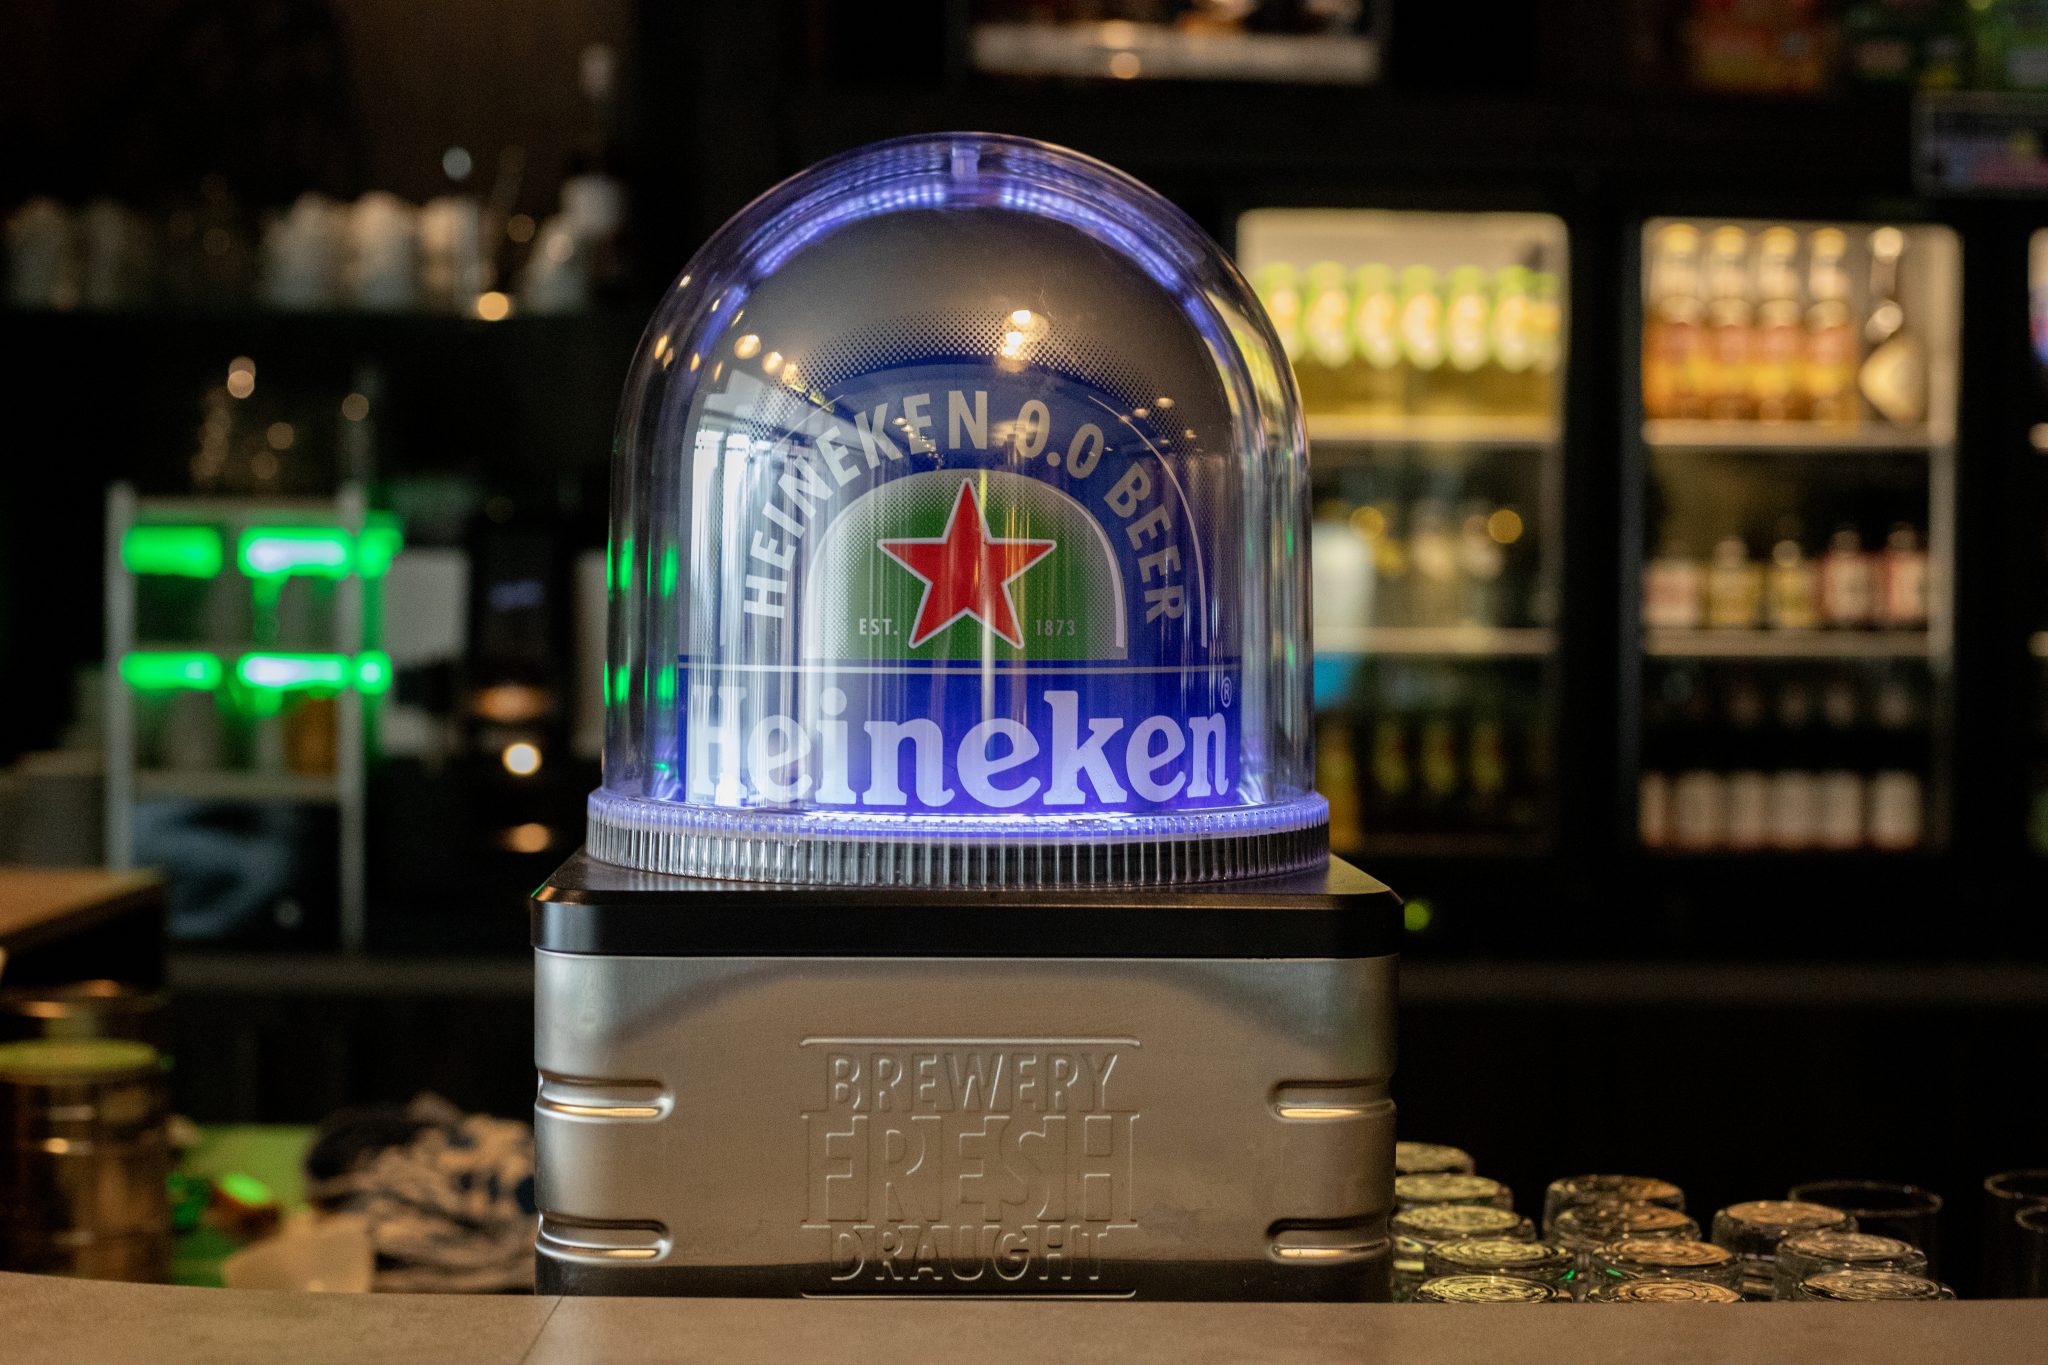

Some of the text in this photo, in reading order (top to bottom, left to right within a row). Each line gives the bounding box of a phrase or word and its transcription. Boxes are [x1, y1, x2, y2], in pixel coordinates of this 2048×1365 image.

[743, 389, 1186, 625] HEINEKEN 0.0 BEER
[858, 618, 1077, 637] EST. 1873
[826, 1052, 1118, 1113] BREWERY
[801, 1114, 1140, 1224] FRESH
[829, 1225, 1110, 1282] DRAUGHT
